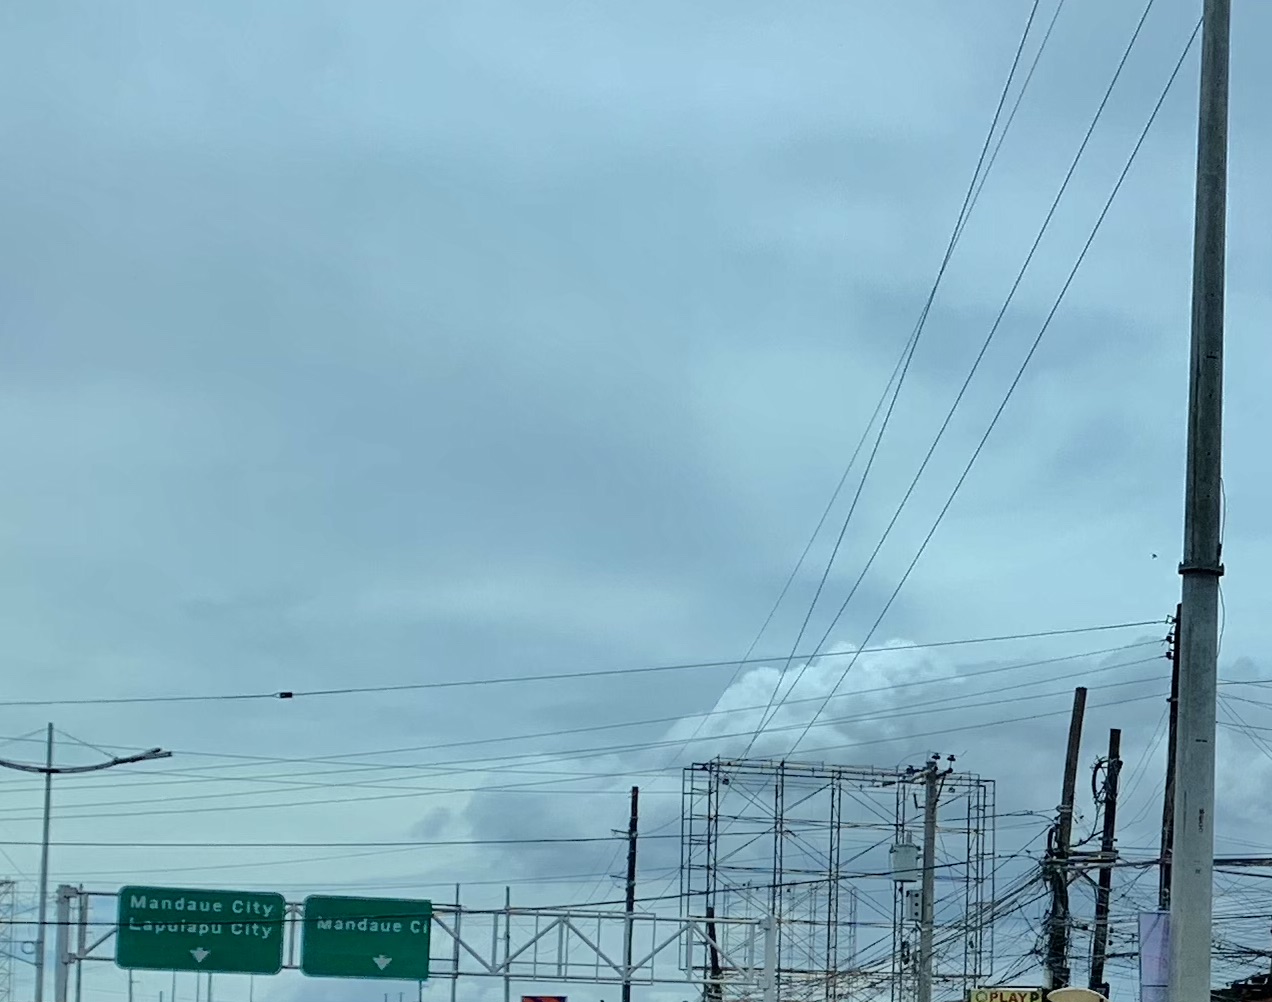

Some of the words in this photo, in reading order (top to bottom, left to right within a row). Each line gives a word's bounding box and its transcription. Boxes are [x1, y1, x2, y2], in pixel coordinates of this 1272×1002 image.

[130, 895, 223, 913] Mandaue
[232, 900, 274, 918] City
[231, 923, 272, 939] City
[316, 915, 402, 933] Mandaue
